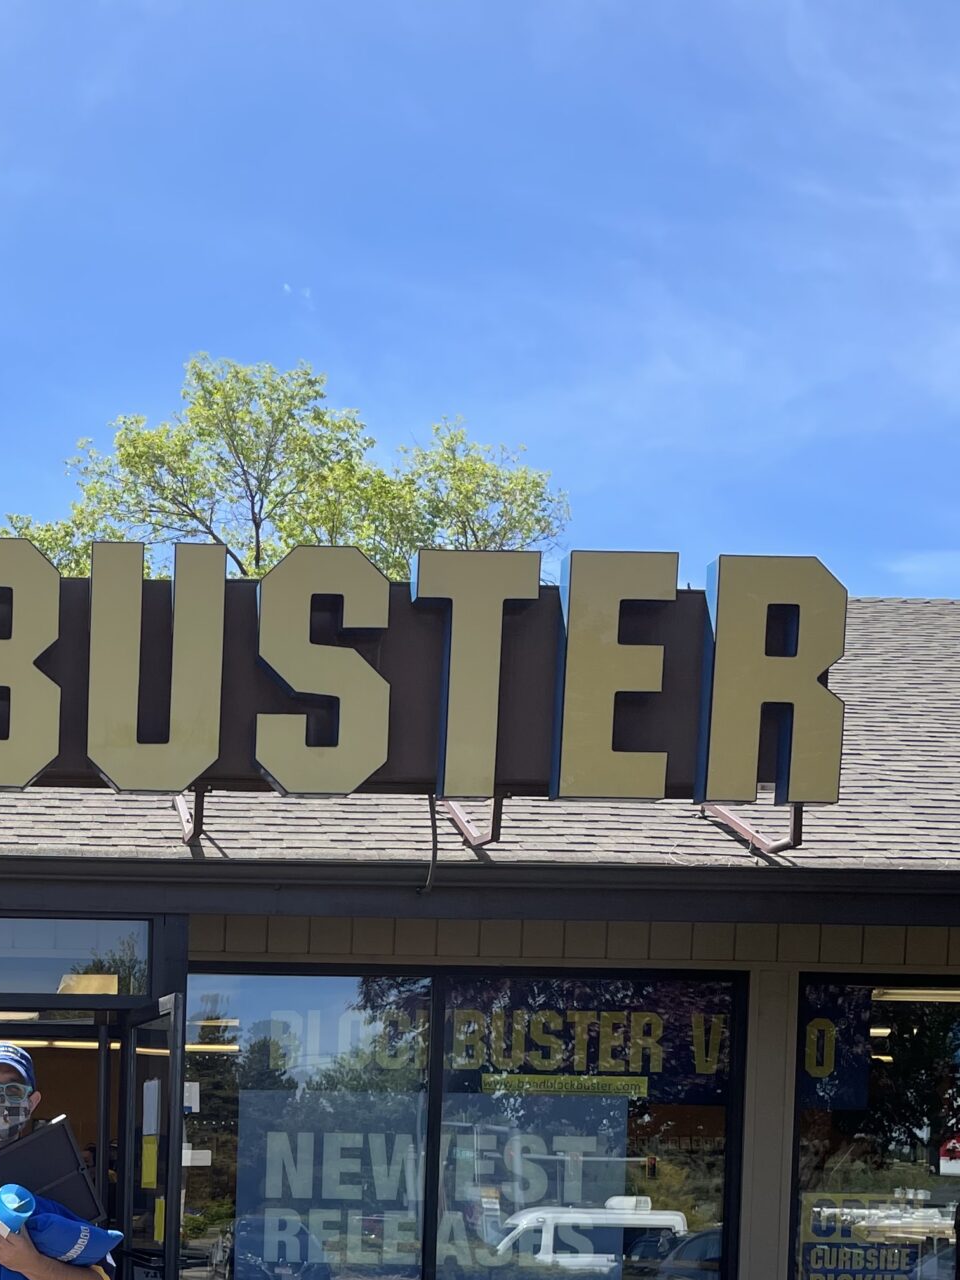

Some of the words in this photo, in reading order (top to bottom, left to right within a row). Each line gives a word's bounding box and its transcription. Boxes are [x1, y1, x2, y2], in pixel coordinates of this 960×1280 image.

[269, 1008, 662, 1074] BLOCKBUSTER
[265, 1130, 597, 1203] NEWEST
[263, 1208, 595, 1267] RELEASES
[810, 1248, 911, 1270] CURBSIDE
